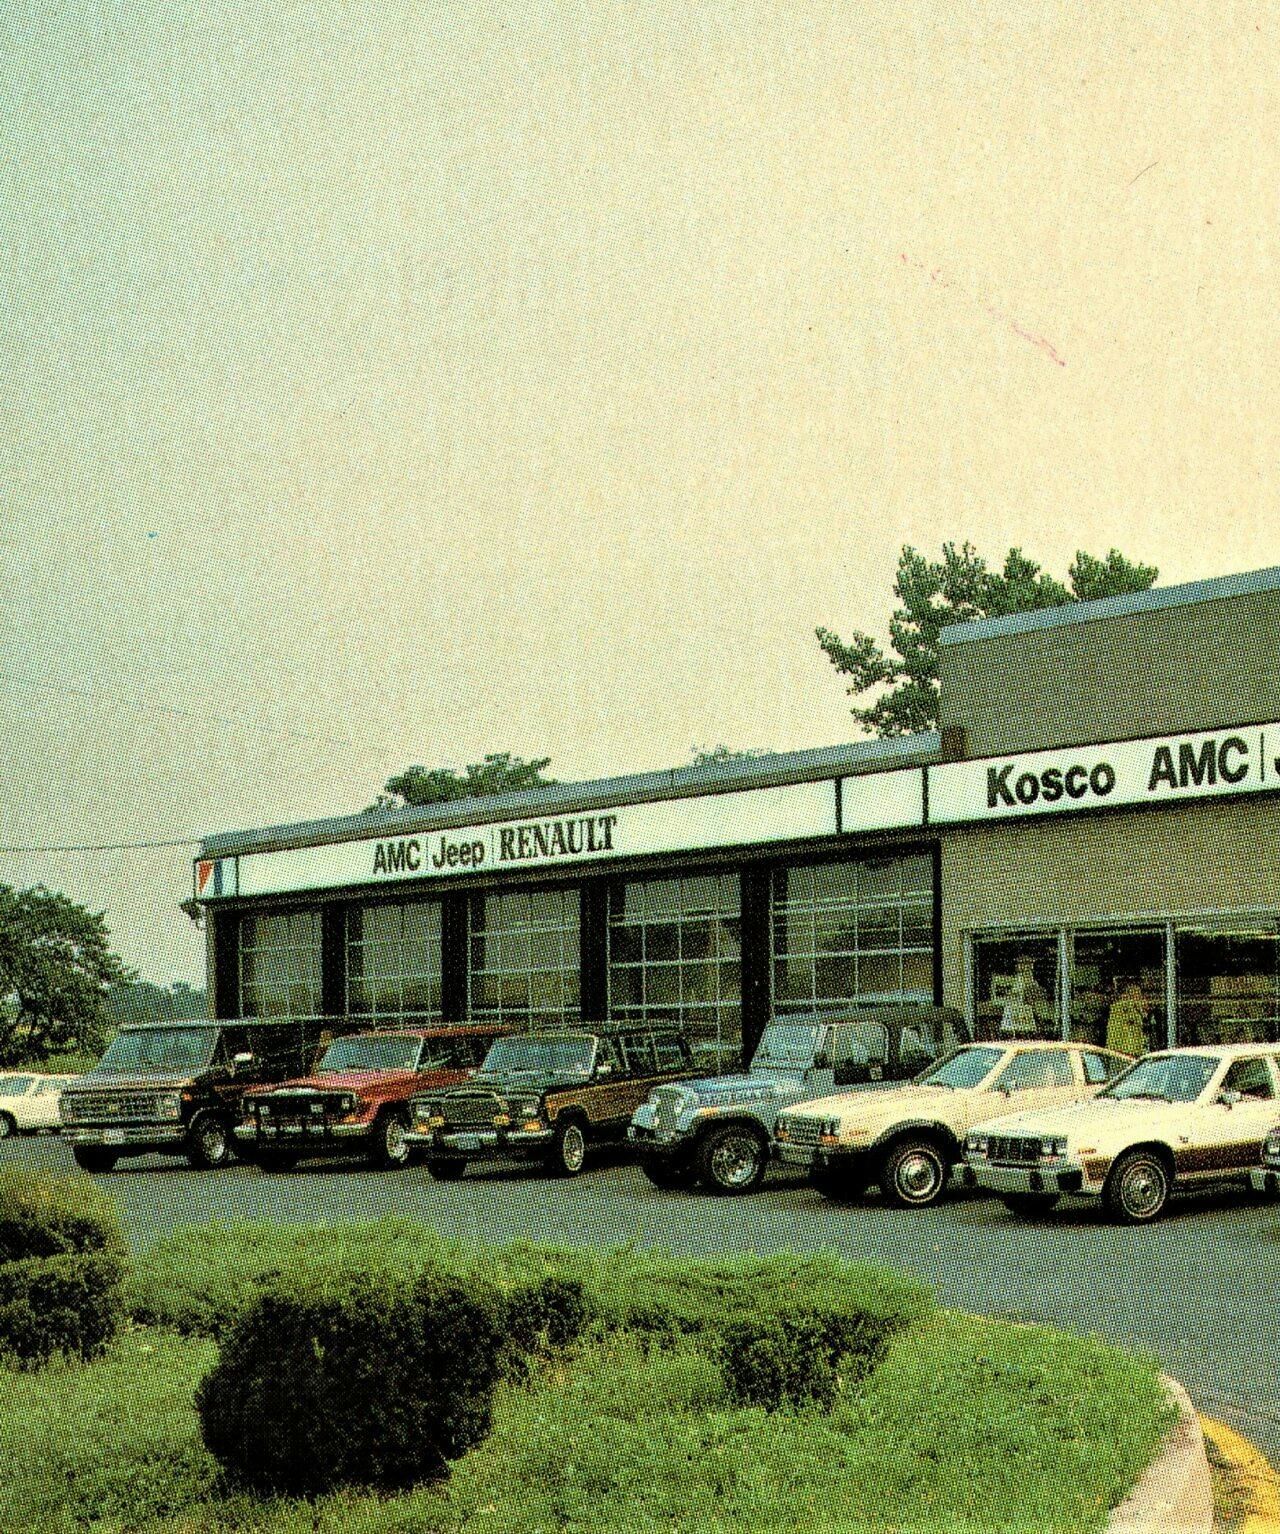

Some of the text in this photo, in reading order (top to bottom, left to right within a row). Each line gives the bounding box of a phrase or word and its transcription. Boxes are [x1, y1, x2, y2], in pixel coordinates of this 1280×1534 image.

[986, 763, 1116, 808] Kosco
[1148, 736, 1250, 791] AMC
[373, 816, 617, 874] AMC Jeep RENAULT
